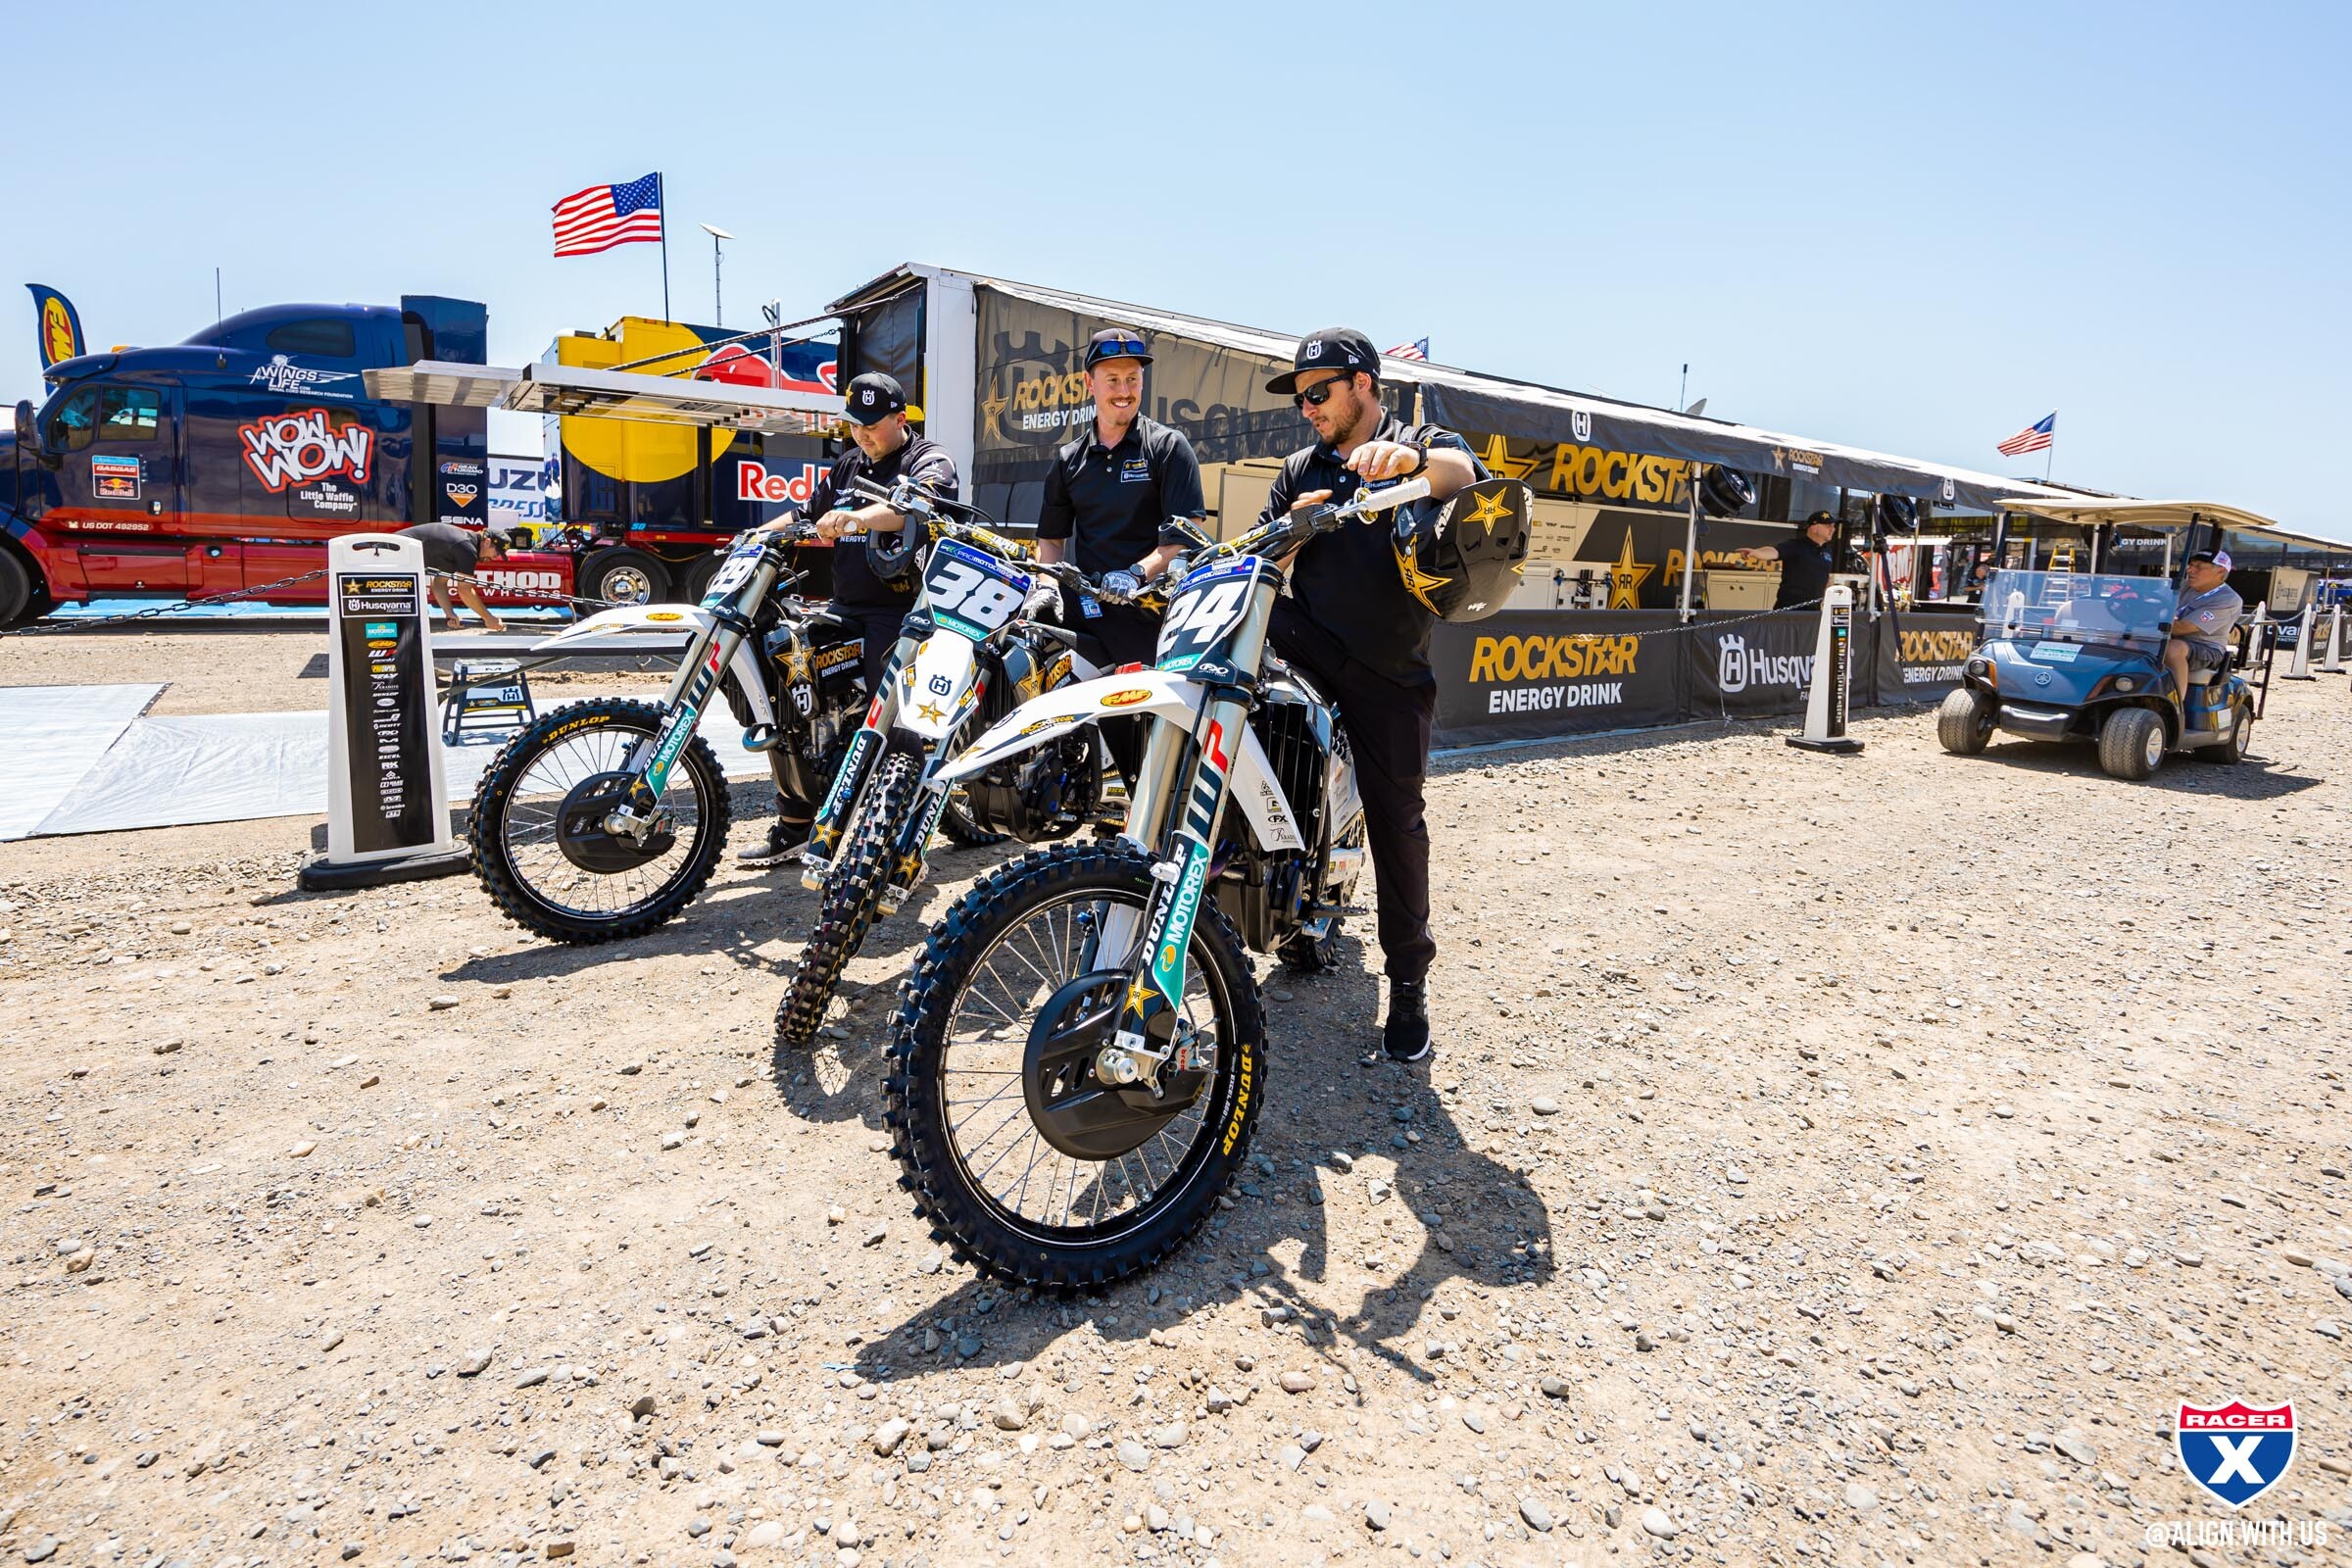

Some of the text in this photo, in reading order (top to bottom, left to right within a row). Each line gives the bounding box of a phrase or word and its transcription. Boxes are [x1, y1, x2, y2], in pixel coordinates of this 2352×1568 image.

[261, 367, 318, 380] WINGS
[269, 378, 301, 390] LIFE
[1013, 371, 1095, 411] ROCKST
[1023, 405, 1098, 430] ENERGY DRIN
[245, 413, 325, 457] WOW
[249, 428, 368, 487] WOW!
[1788, 449, 1824, 467] ROCKSTAR
[321, 482, 337, 492] The
[488, 467, 545, 491] UZ
[738, 461, 815, 505] Red
[1549, 443, 1693, 505] ROCKST
[301, 492, 354, 502] Little Waffle
[315, 500, 354, 513] Company
[441, 515, 484, 526] SENA
[2136, 538, 2168, 547] DRINK
[366, 580, 413, 589] ROCKSTAR
[926, 560, 1025, 629] 38
[361, 600, 411, 611] Husqvarna
[1157, 580, 1249, 657] 24
[948, 617, 980, 638] MOTOREX
[815, 643, 862, 670] ROCKSTAR
[1470, 635, 1639, 683] ROCKSTAR
[1895, 631, 1974, 662] ROCKSTAR
[821, 659, 859, 677] ENERGY DRINK
[1749, 649, 1815, 690] Husqv
[1903, 666, 1937, 683] ENERGY
[1101, 689, 1152, 706] FMF
[1489, 682, 1623, 714] ENERGY DRINK
[549, 716, 611, 741] DUNLOP
[645, 707, 682, 771] DUNLP
[661, 713, 695, 762] MOTOREX
[915, 794, 942, 849] DUNL
[1142, 845, 1188, 967] DUNLP
[1166, 850, 1208, 945] MOTOREX
[1223, 1054, 1252, 1156] DUNLOP
